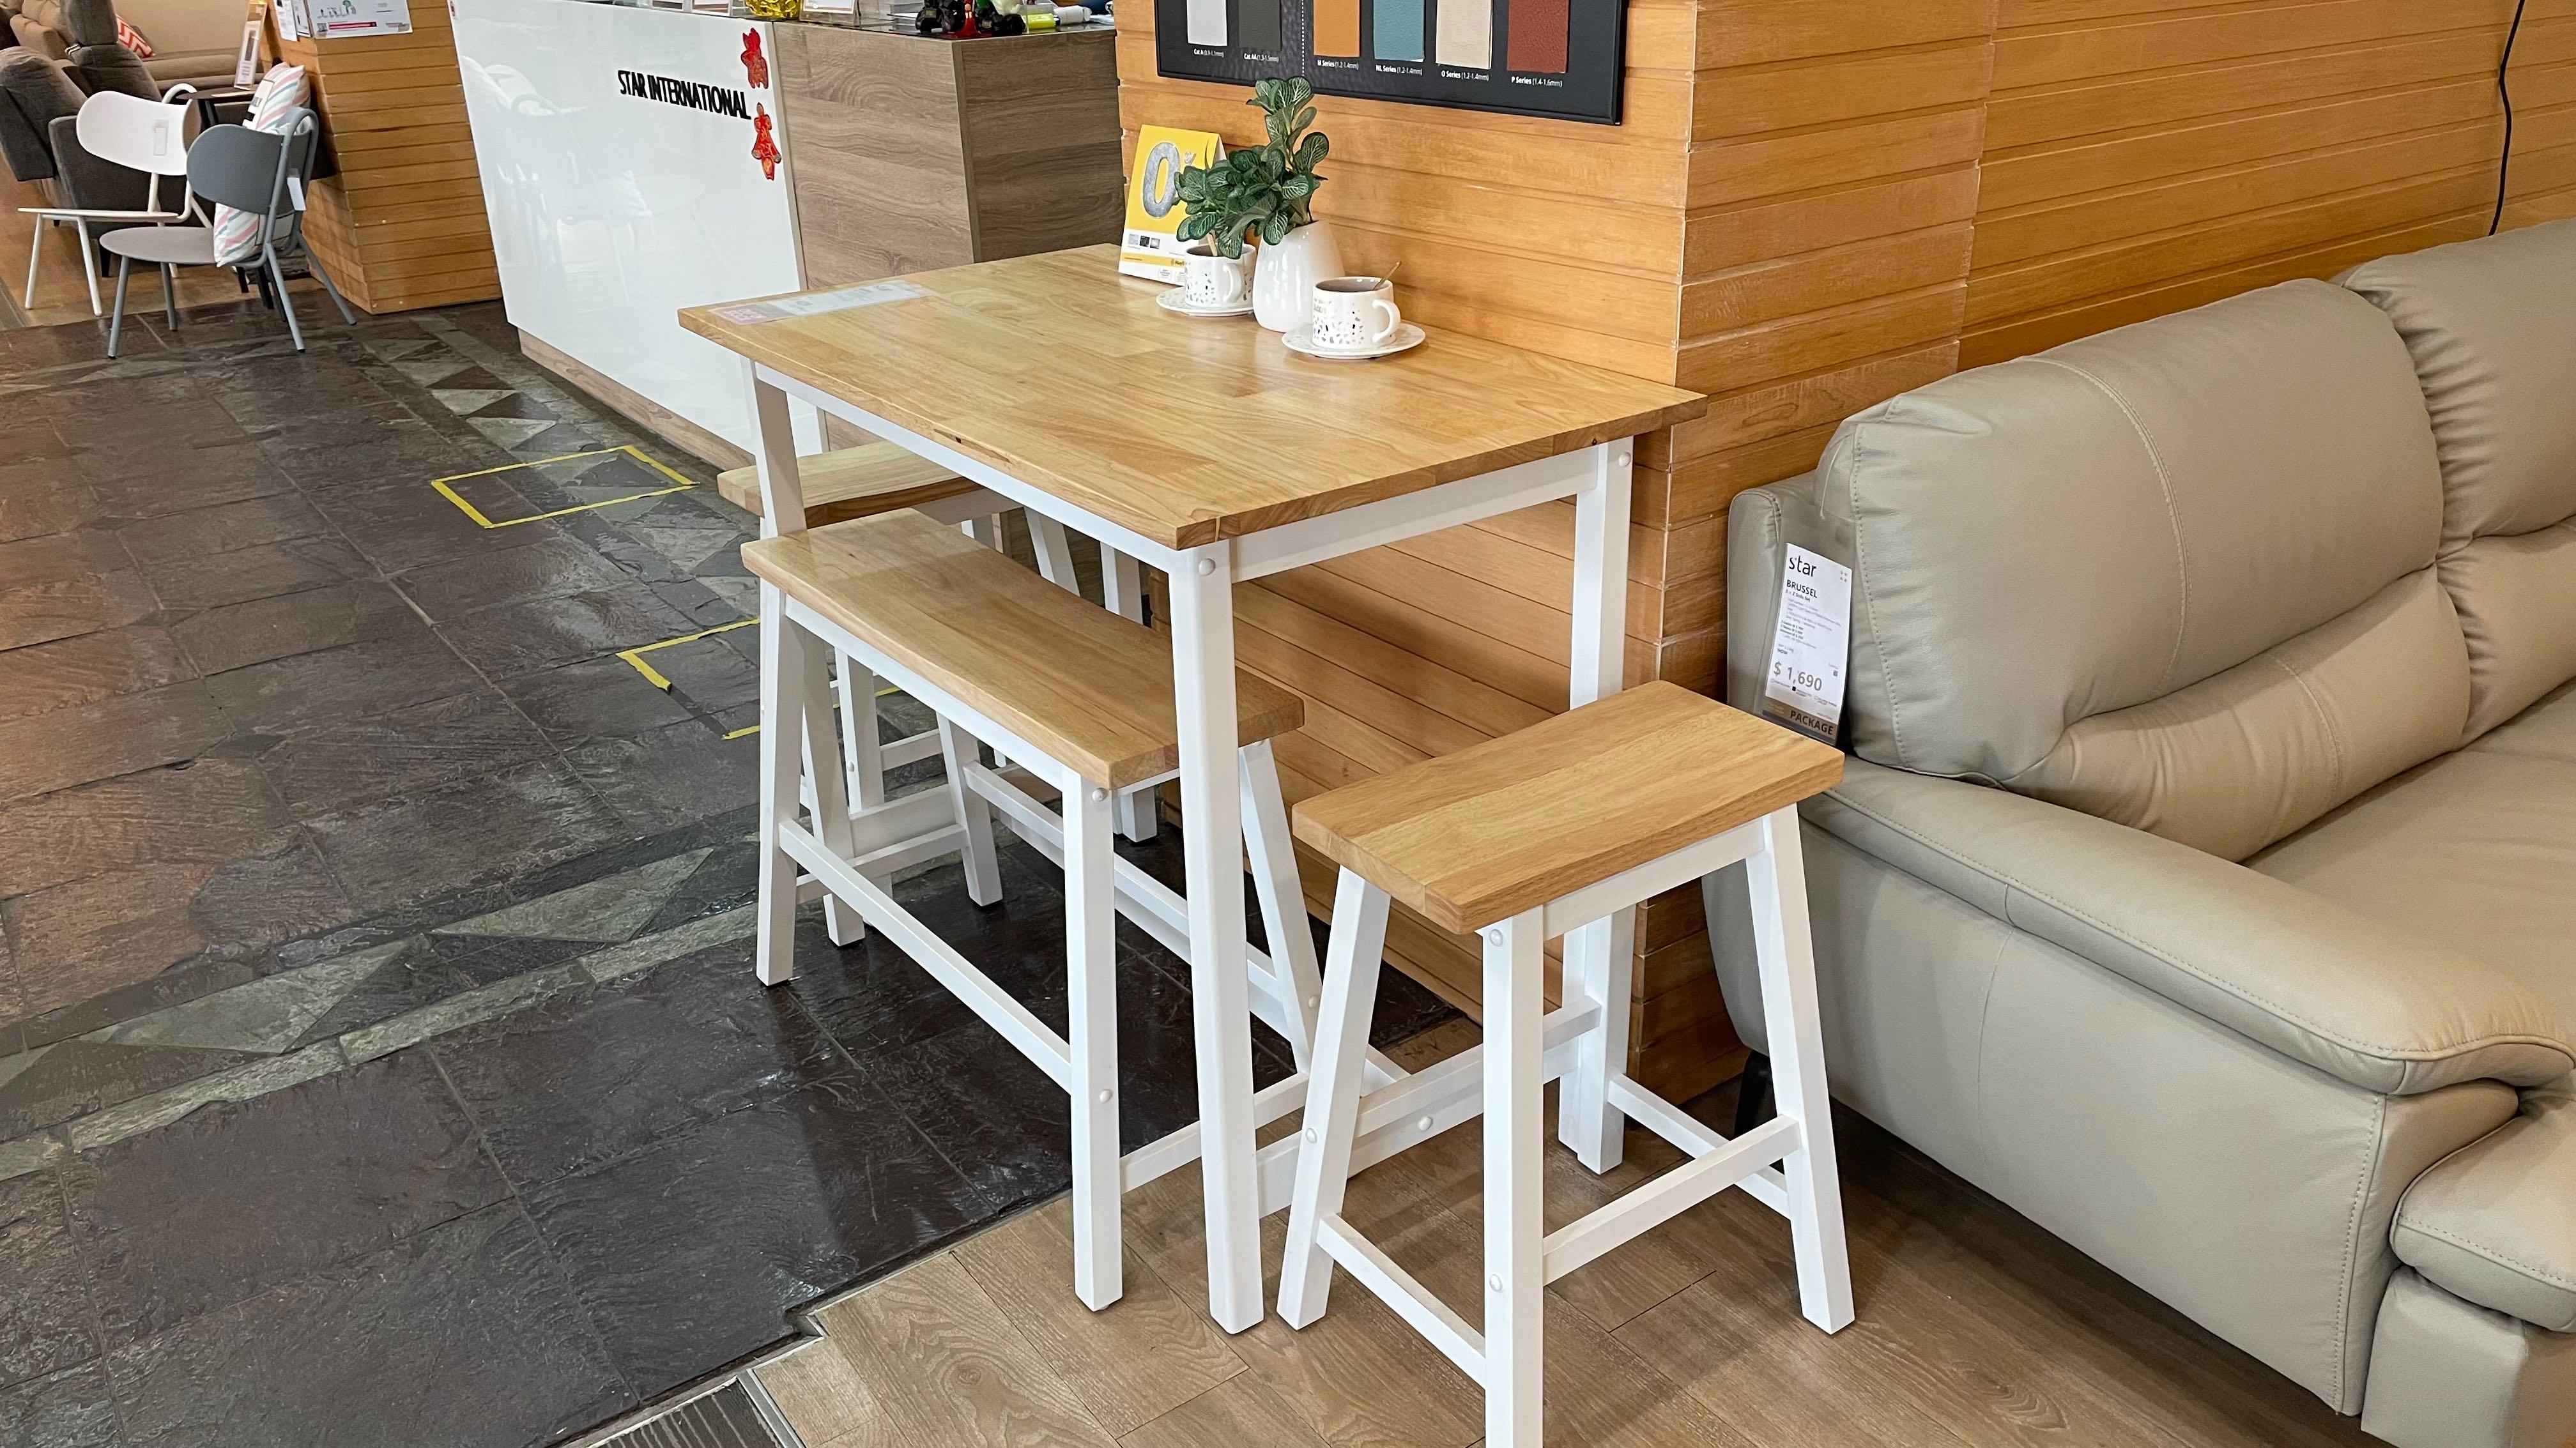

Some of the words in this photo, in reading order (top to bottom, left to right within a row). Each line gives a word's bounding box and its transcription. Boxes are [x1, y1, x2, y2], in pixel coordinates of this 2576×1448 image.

[1383, 65, 1397, 73] Series
[1446, 70, 1461, 79] Series
[1515, 76, 1531, 84] Series
[618, 70, 648, 98] STAR
[647, 74, 751, 120] INTERNATIONAL
[1789, 556, 1816, 577] star
[1786, 579, 1818, 598] BRUSSEL
[1788, 667, 1822, 691] 1,690
[1790, 710, 1834, 735] PACKAGE
